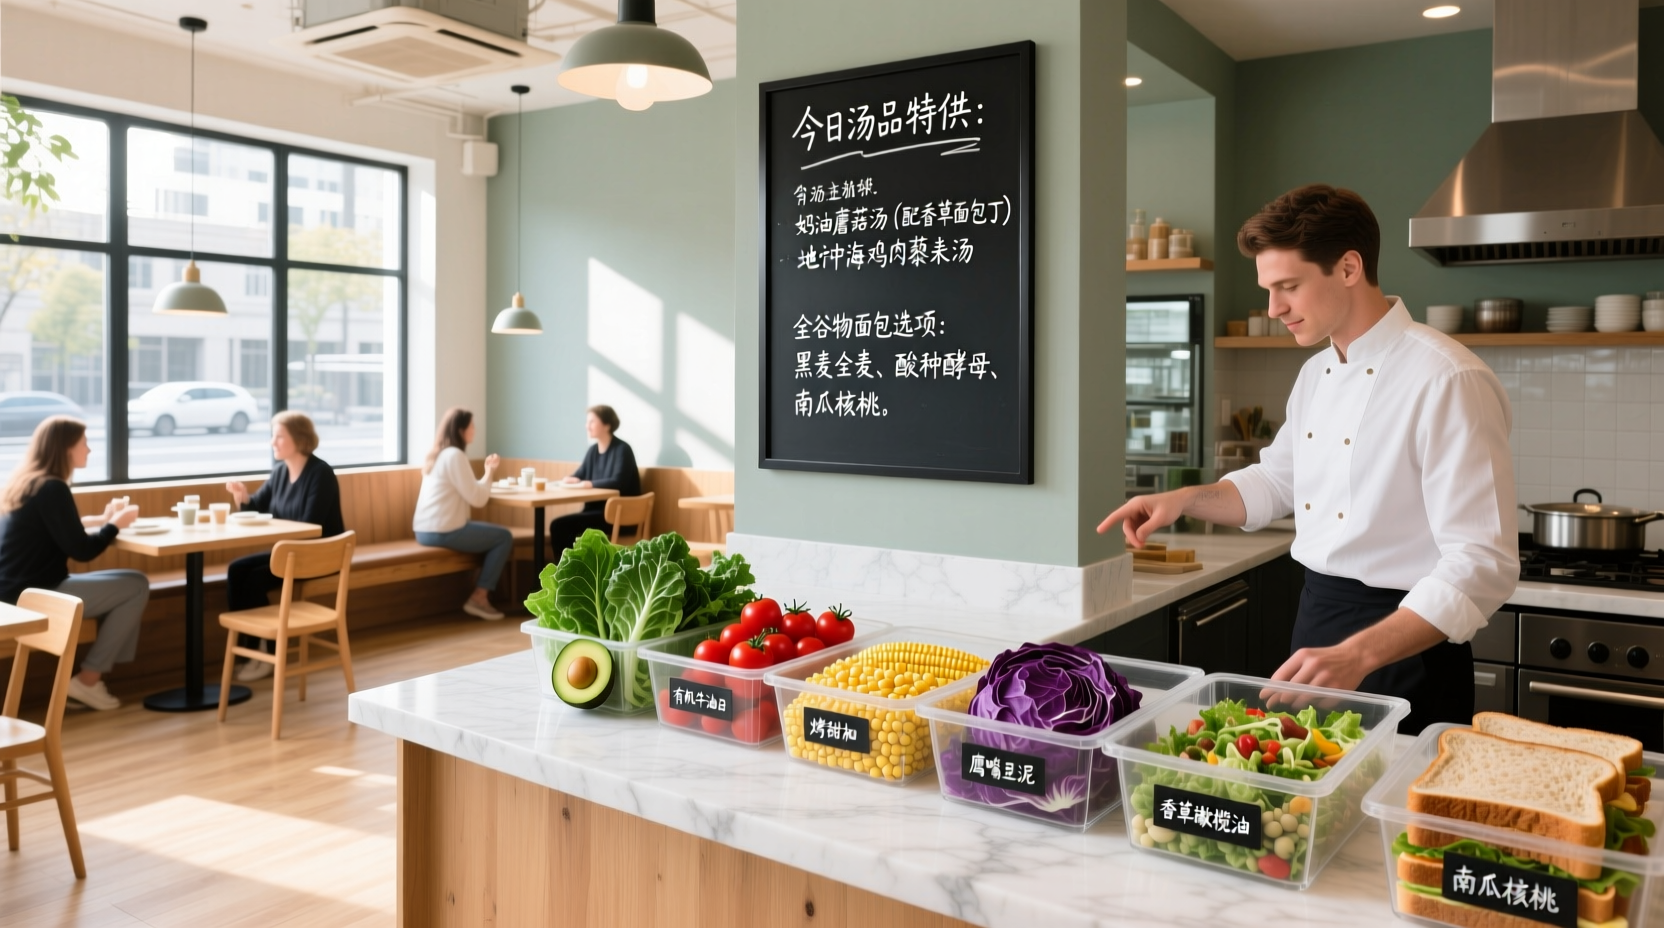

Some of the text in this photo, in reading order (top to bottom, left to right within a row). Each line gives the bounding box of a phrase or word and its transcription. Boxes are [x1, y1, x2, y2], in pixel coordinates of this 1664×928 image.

[792, 91, 983, 151] 今日汤品特供：
[793, 310, 945, 339] 全谷物面包选项：
[795, 349, 998, 380] 黑麦全麦、酸种酵母、
[795, 388, 888, 417] 南瓜核桃。
[1453, 865, 1559, 914] 南瓜核桃
